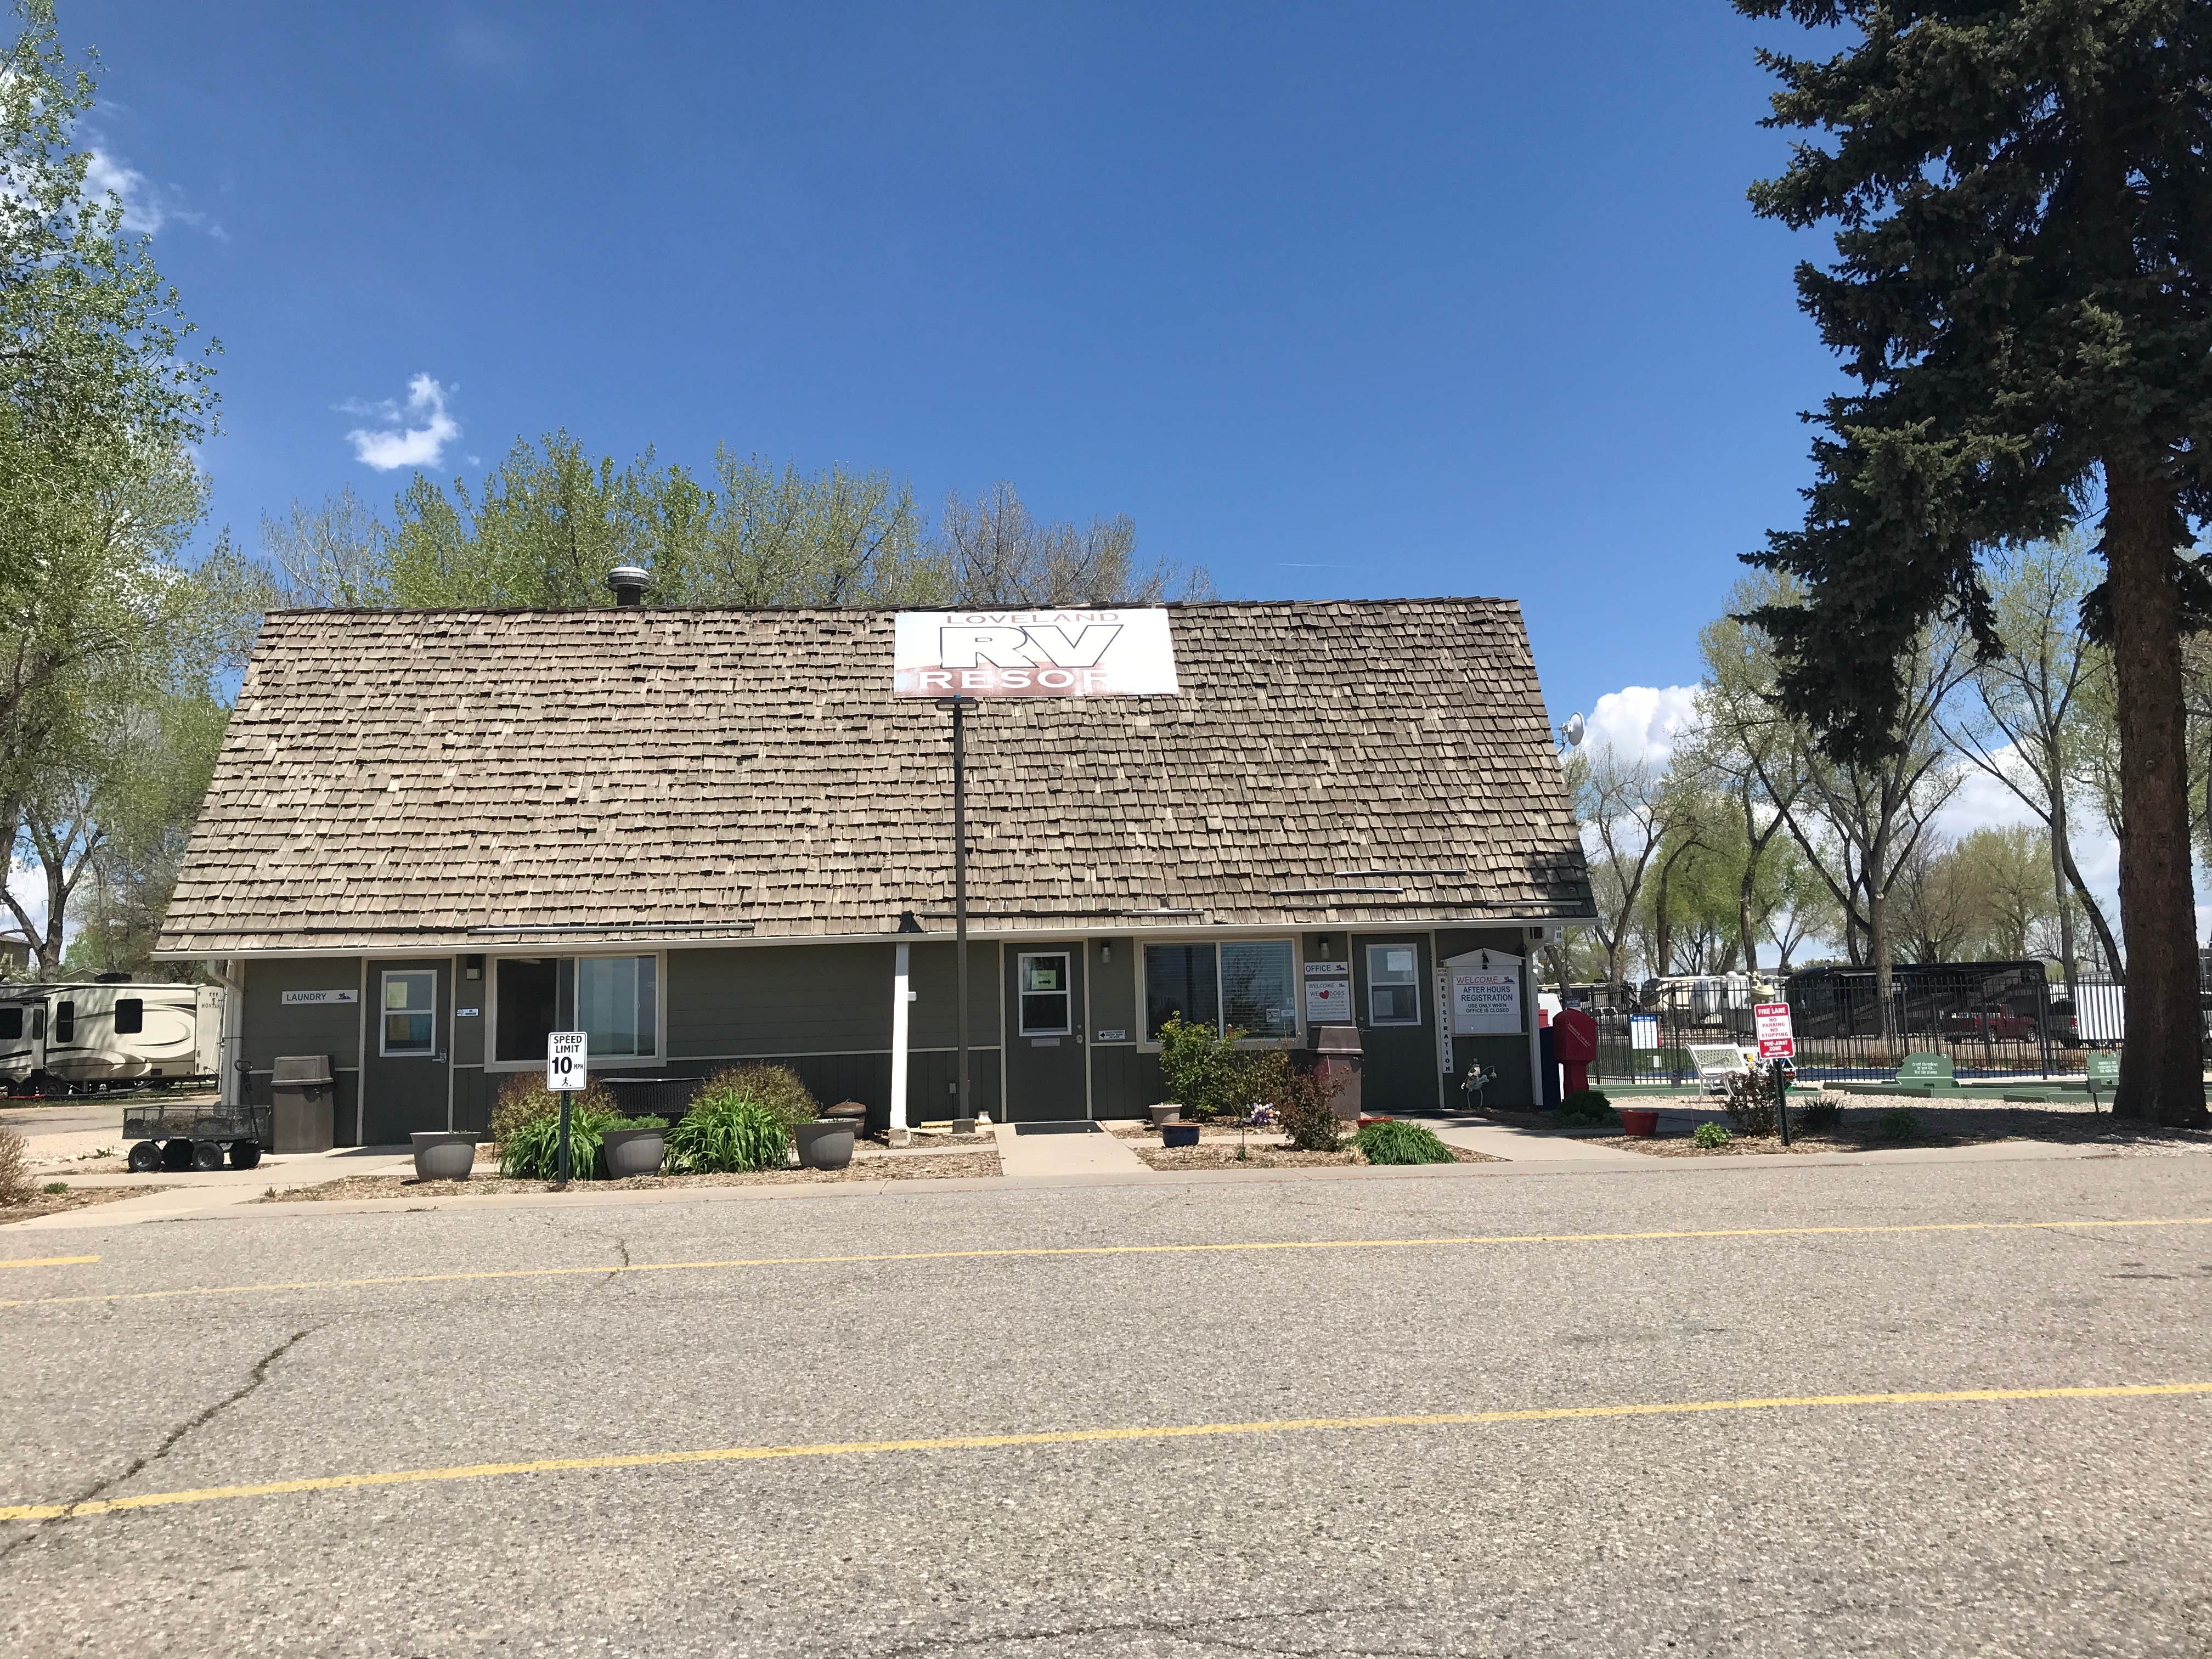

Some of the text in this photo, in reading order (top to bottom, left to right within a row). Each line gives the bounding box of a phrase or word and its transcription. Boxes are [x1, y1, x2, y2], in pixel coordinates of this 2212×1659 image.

[947, 613, 1119, 624] LOVELAND
[939, 624, 1124, 669] RV
[918, 669, 1113, 689] RESOR
[286, 993, 326, 1001] LAUNDRY
[1441, 978, 1450, 1071] REGISTRATION
[552, 1056, 572, 1074] 10
